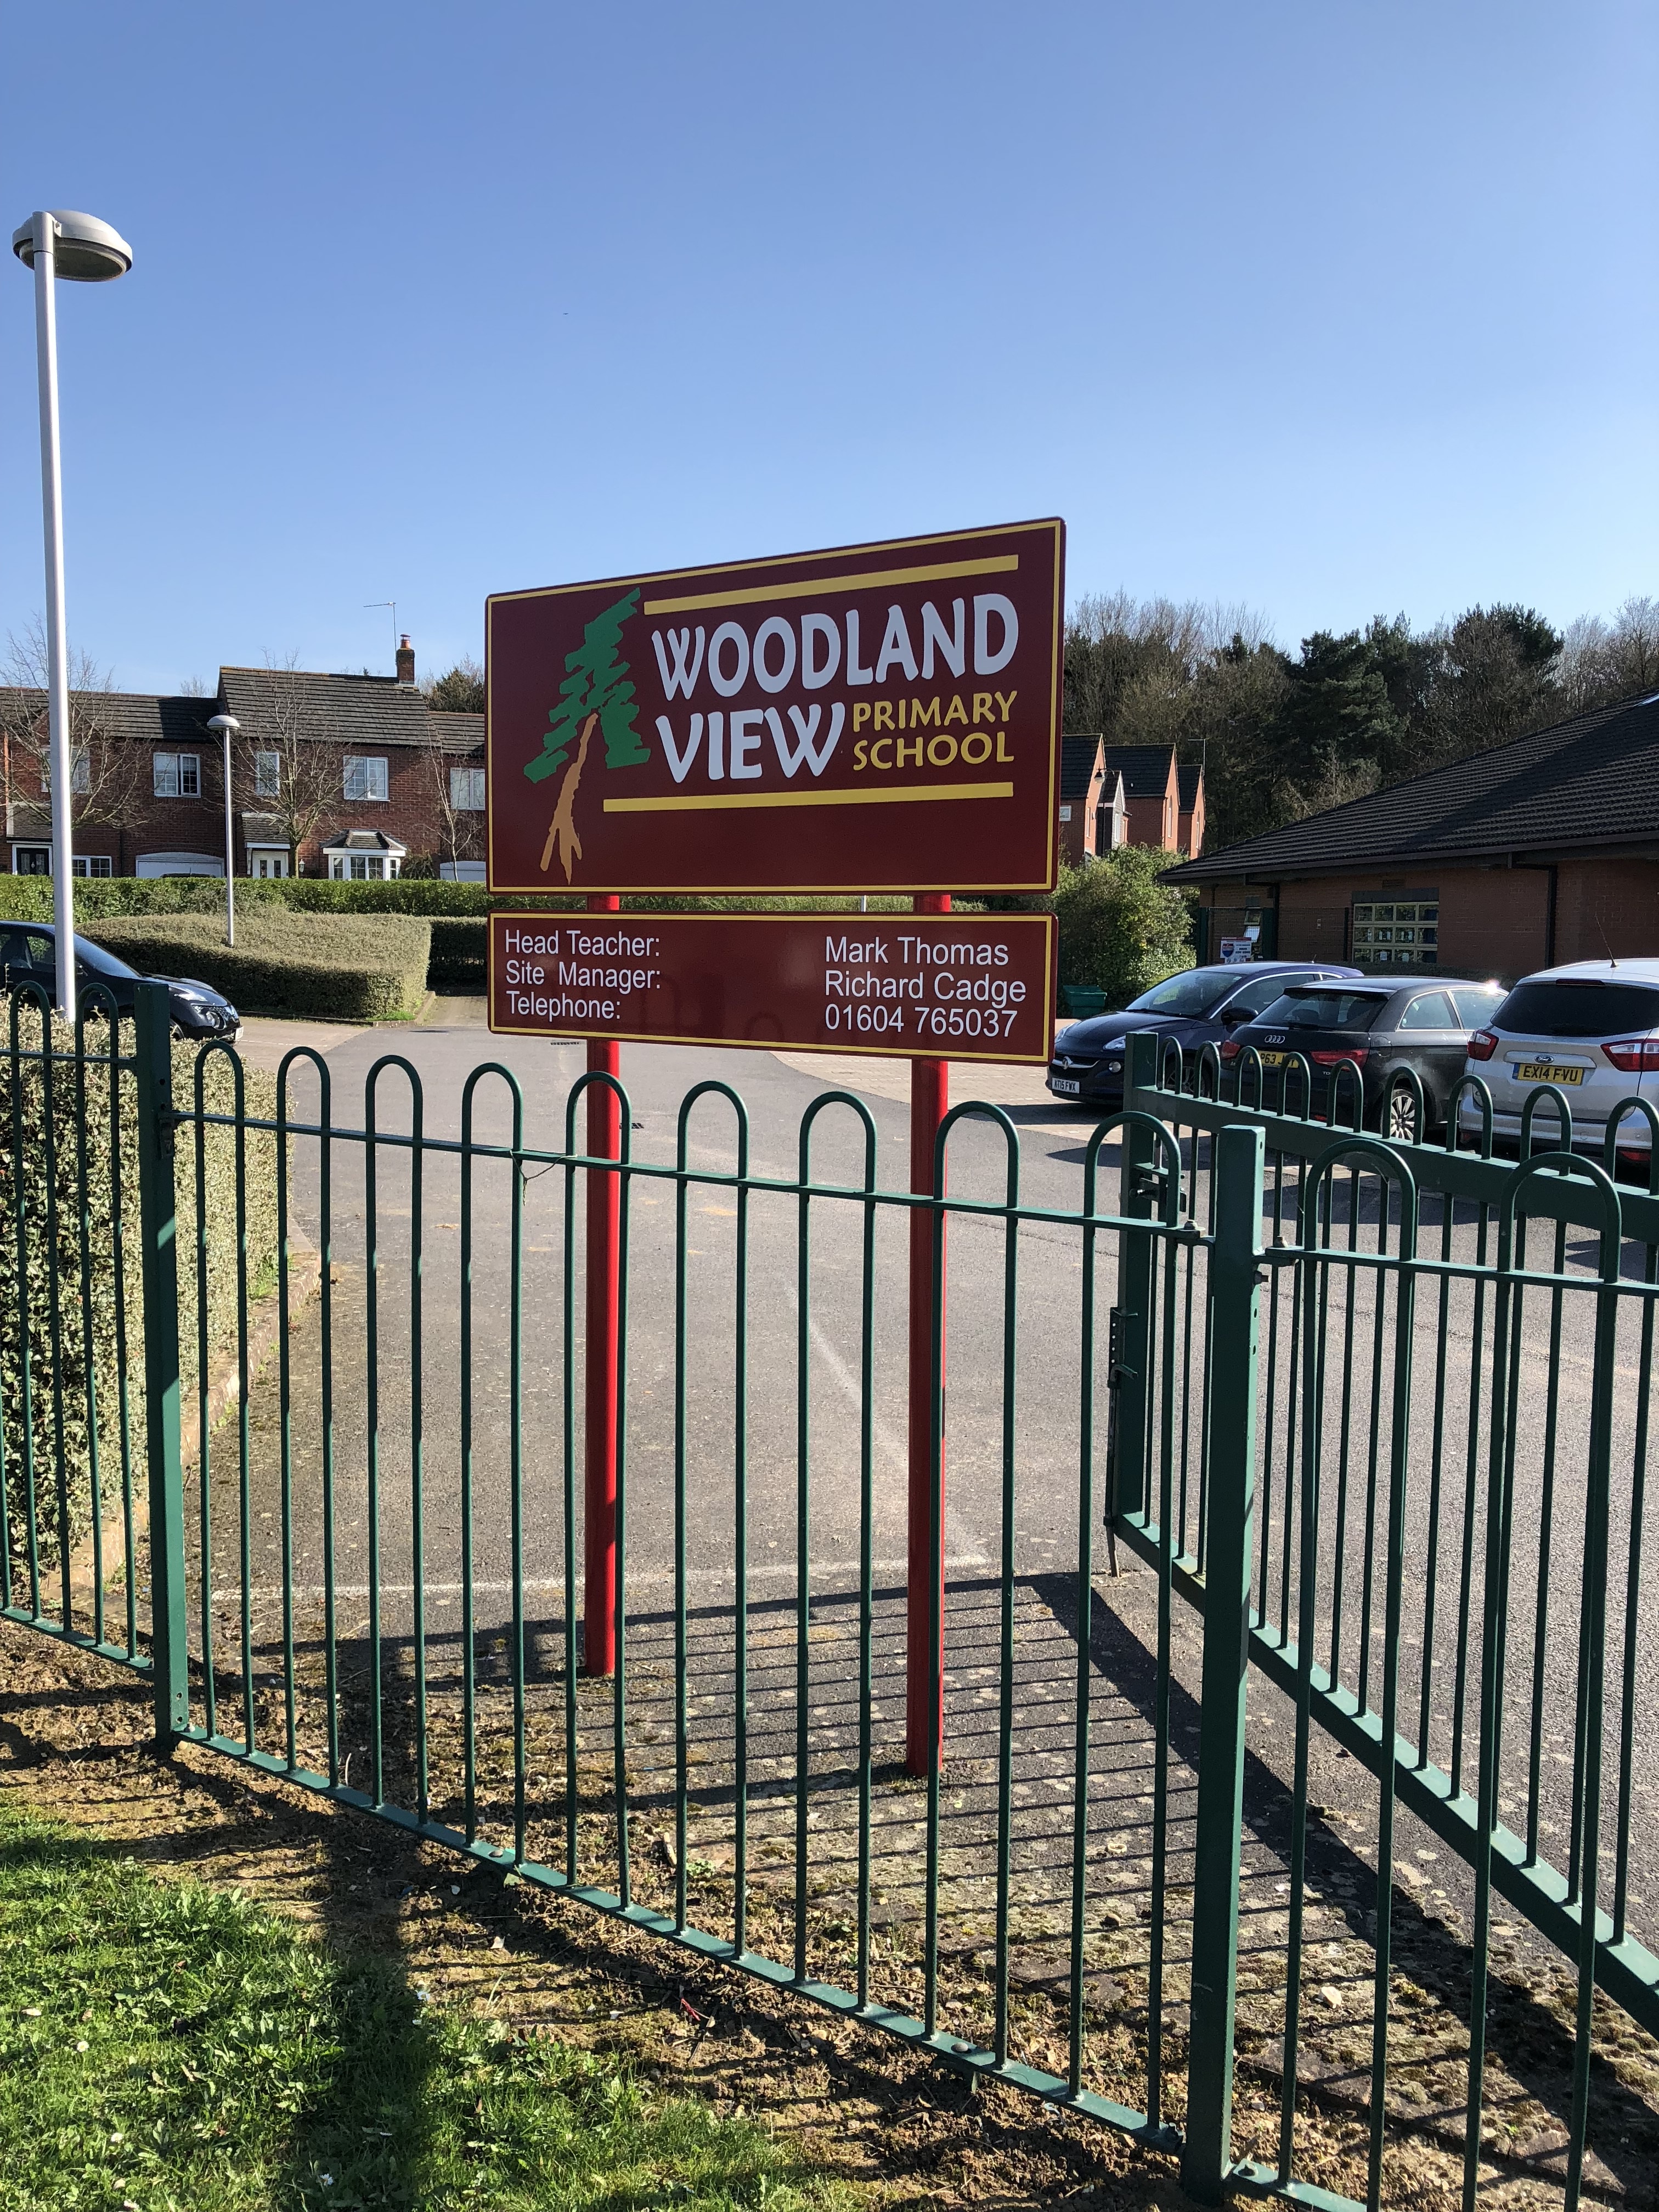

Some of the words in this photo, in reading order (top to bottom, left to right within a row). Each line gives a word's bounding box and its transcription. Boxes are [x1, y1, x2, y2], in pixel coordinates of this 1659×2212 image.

[651, 593, 1019, 701] WOODLAND
[853, 691, 1017, 732] PRIMARY
[655, 702, 845, 783] VIEW
[853, 732, 1014, 771] SCHOOL
[505, 929, 559, 955] Head
[566, 930, 660, 957] Teacher:
[825, 936, 889, 963] Mark
[897, 936, 1009, 966] Thomas
[505, 960, 545, 985] Site
[559, 961, 661, 995] Manager:
[825, 970, 924, 1000] Richard
[934, 972, 1026, 1009] Cadge
[505, 990, 620, 1022] Telephone:
[825, 1003, 905, 1032] 01604
[915, 1006, 1018, 1037] 765037
[1257, 1053, 1277, 1064] P63
[1523, 1065, 1550, 1080] EX14
[1553, 1068, 1578, 1082] FVU
